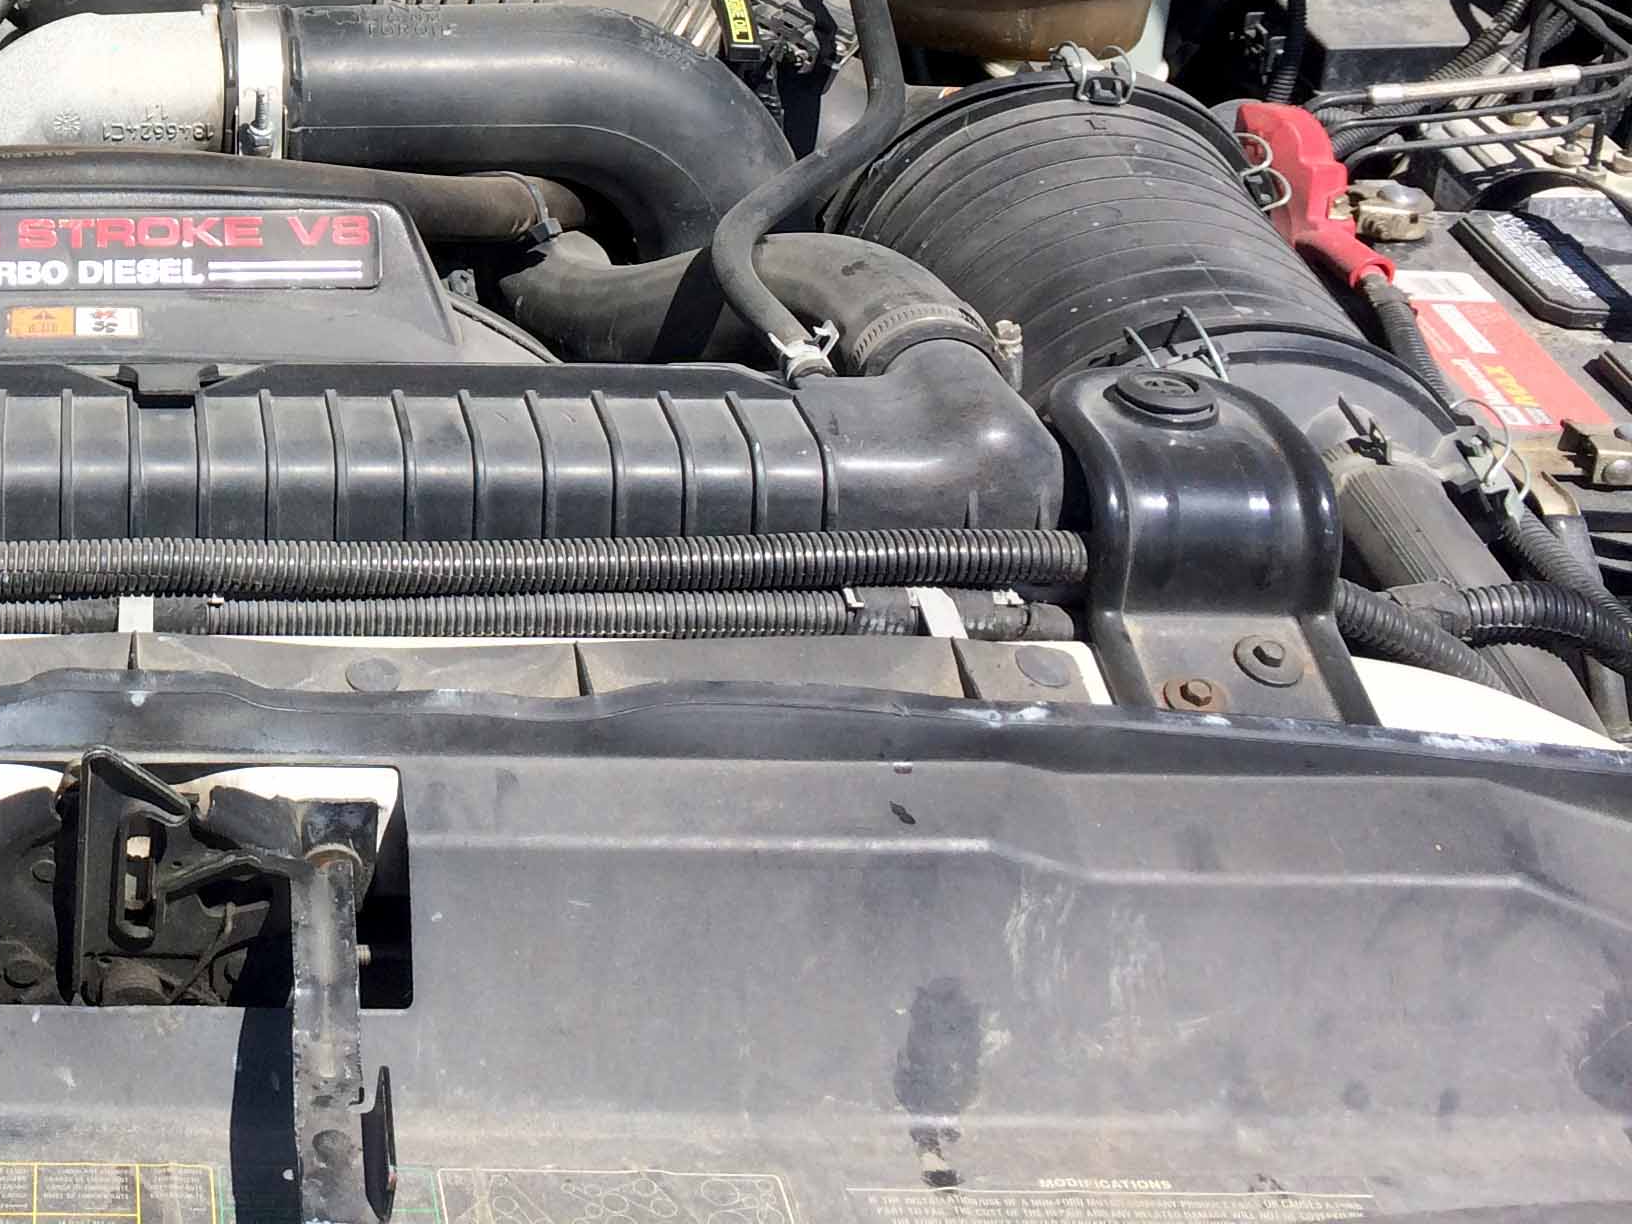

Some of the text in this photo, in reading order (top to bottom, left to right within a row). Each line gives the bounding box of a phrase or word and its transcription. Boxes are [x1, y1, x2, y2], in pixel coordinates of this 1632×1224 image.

[18, 215, 264, 250] STROKE
[287, 215, 371, 248] V8
[77, 258, 206, 285] DIESEL
[1039, 1177, 1173, 1190] MODIFICATIONS
